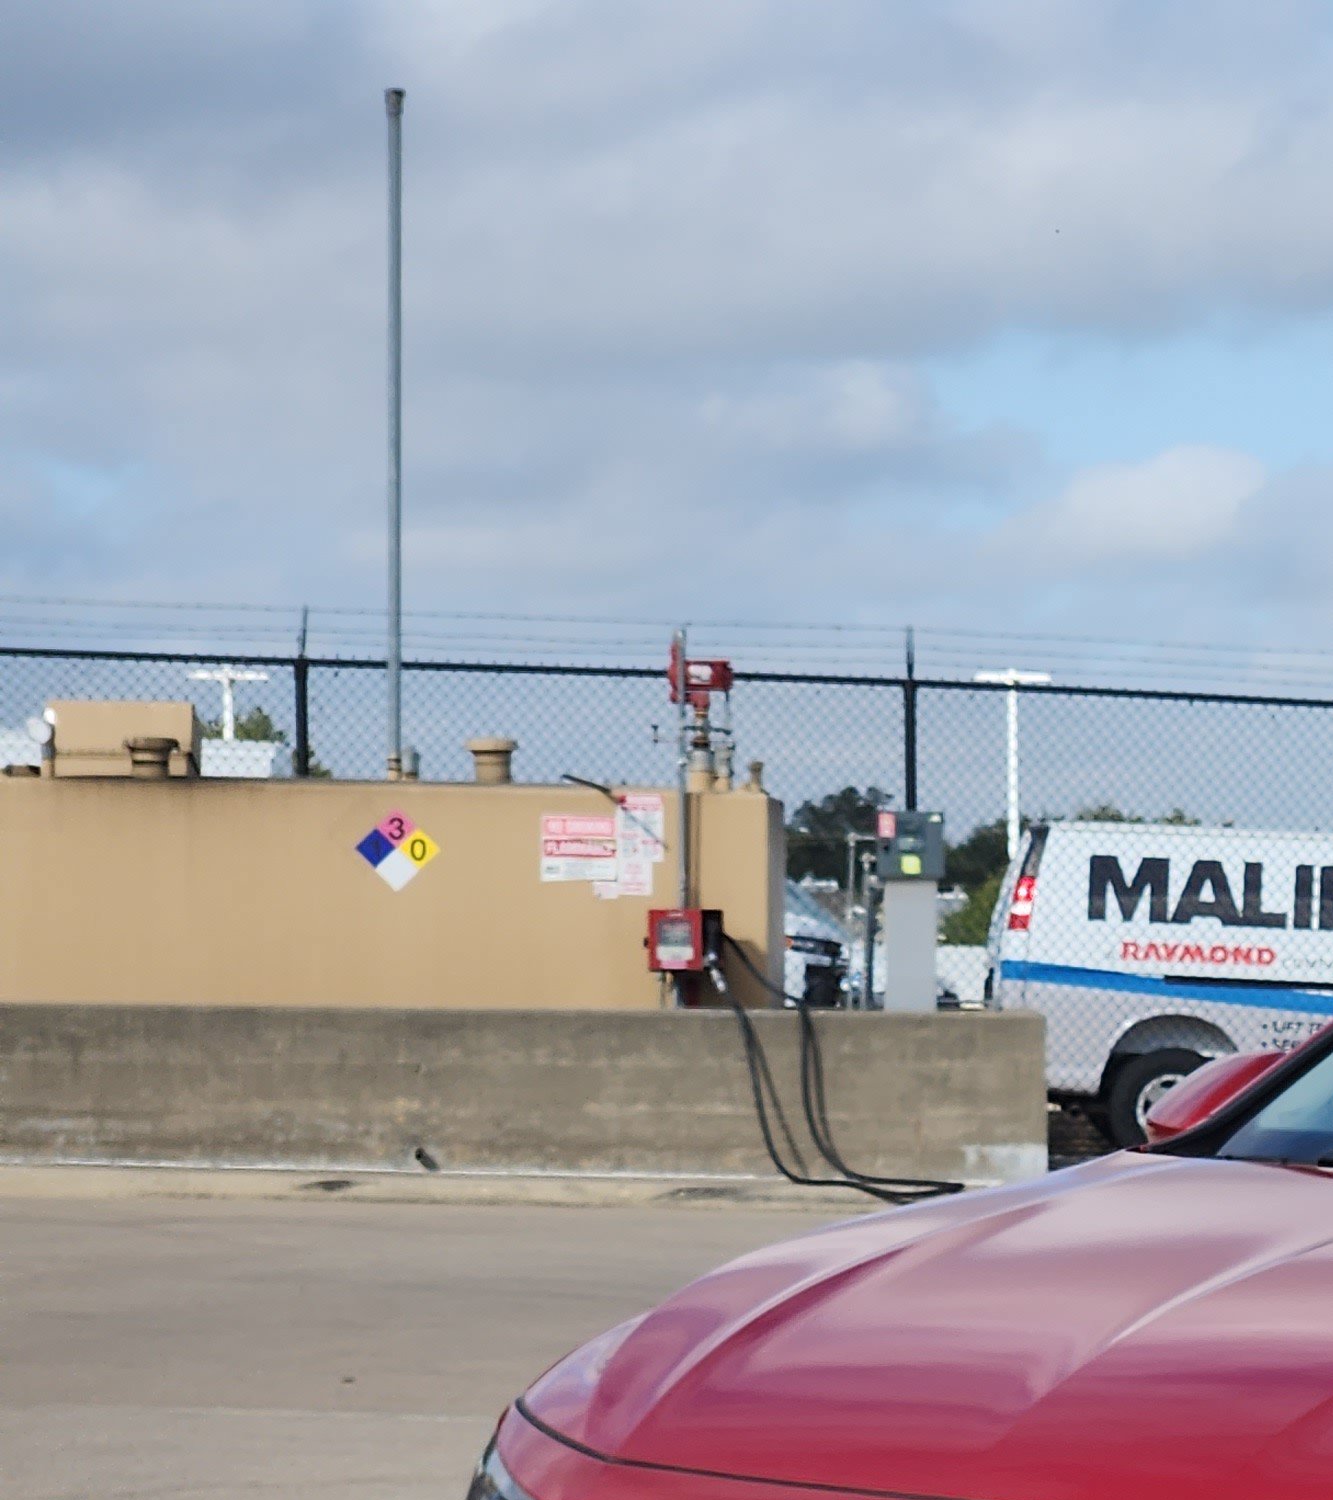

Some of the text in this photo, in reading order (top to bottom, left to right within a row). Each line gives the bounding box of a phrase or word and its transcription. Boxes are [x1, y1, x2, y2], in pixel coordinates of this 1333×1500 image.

[389, 817, 405, 840] 3
[410, 838, 426, 861] 0
[1120, 942, 1277, 966] RAYMOND
